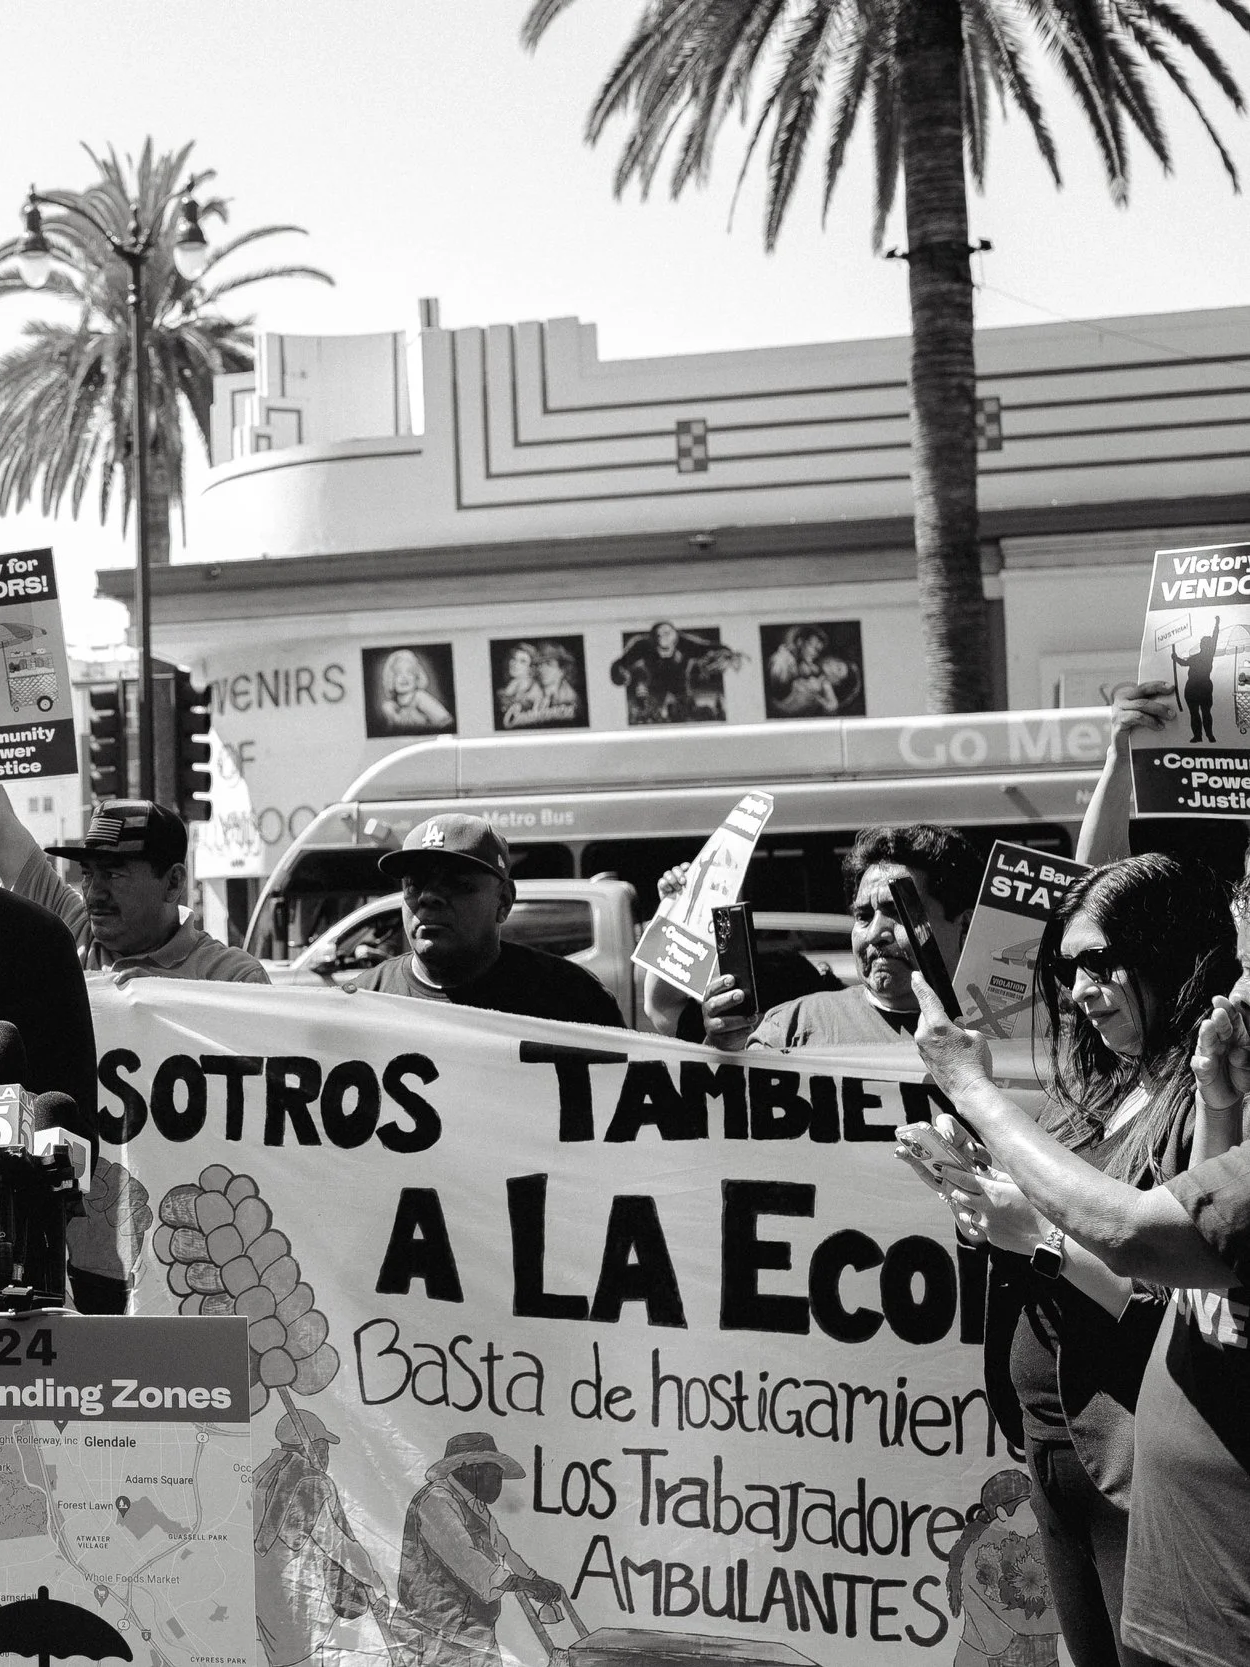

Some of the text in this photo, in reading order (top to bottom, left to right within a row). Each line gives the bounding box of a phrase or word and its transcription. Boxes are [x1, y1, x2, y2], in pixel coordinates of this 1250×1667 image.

[7, 558, 38, 574] for
[899, 717, 1111, 768] Go Me
[1163, 753, 1250, 770] Commu
[482, 808, 575, 828] Metro Bus
[997, 854, 1035, 878] L.A.
[97, 1048, 442, 1154] SOTROS
[377, 1187, 464, 1303] A
[506, 1173, 688, 1330] LA
[354, 1319, 544, 1416] Basta
[571, 1342, 636, 1424] de
[112, 1379, 232, 1409] Zones
[84, 1436, 137, 1448] Glendale
[125, 1475, 193, 1487] Adams Square
[58, 1501, 114, 1511] Forest Lawn
[76, 1535, 110, 1543] ATWATER
[84, 1573, 113, 1583] Whole
[147, 1574, 180, 1584] Market
